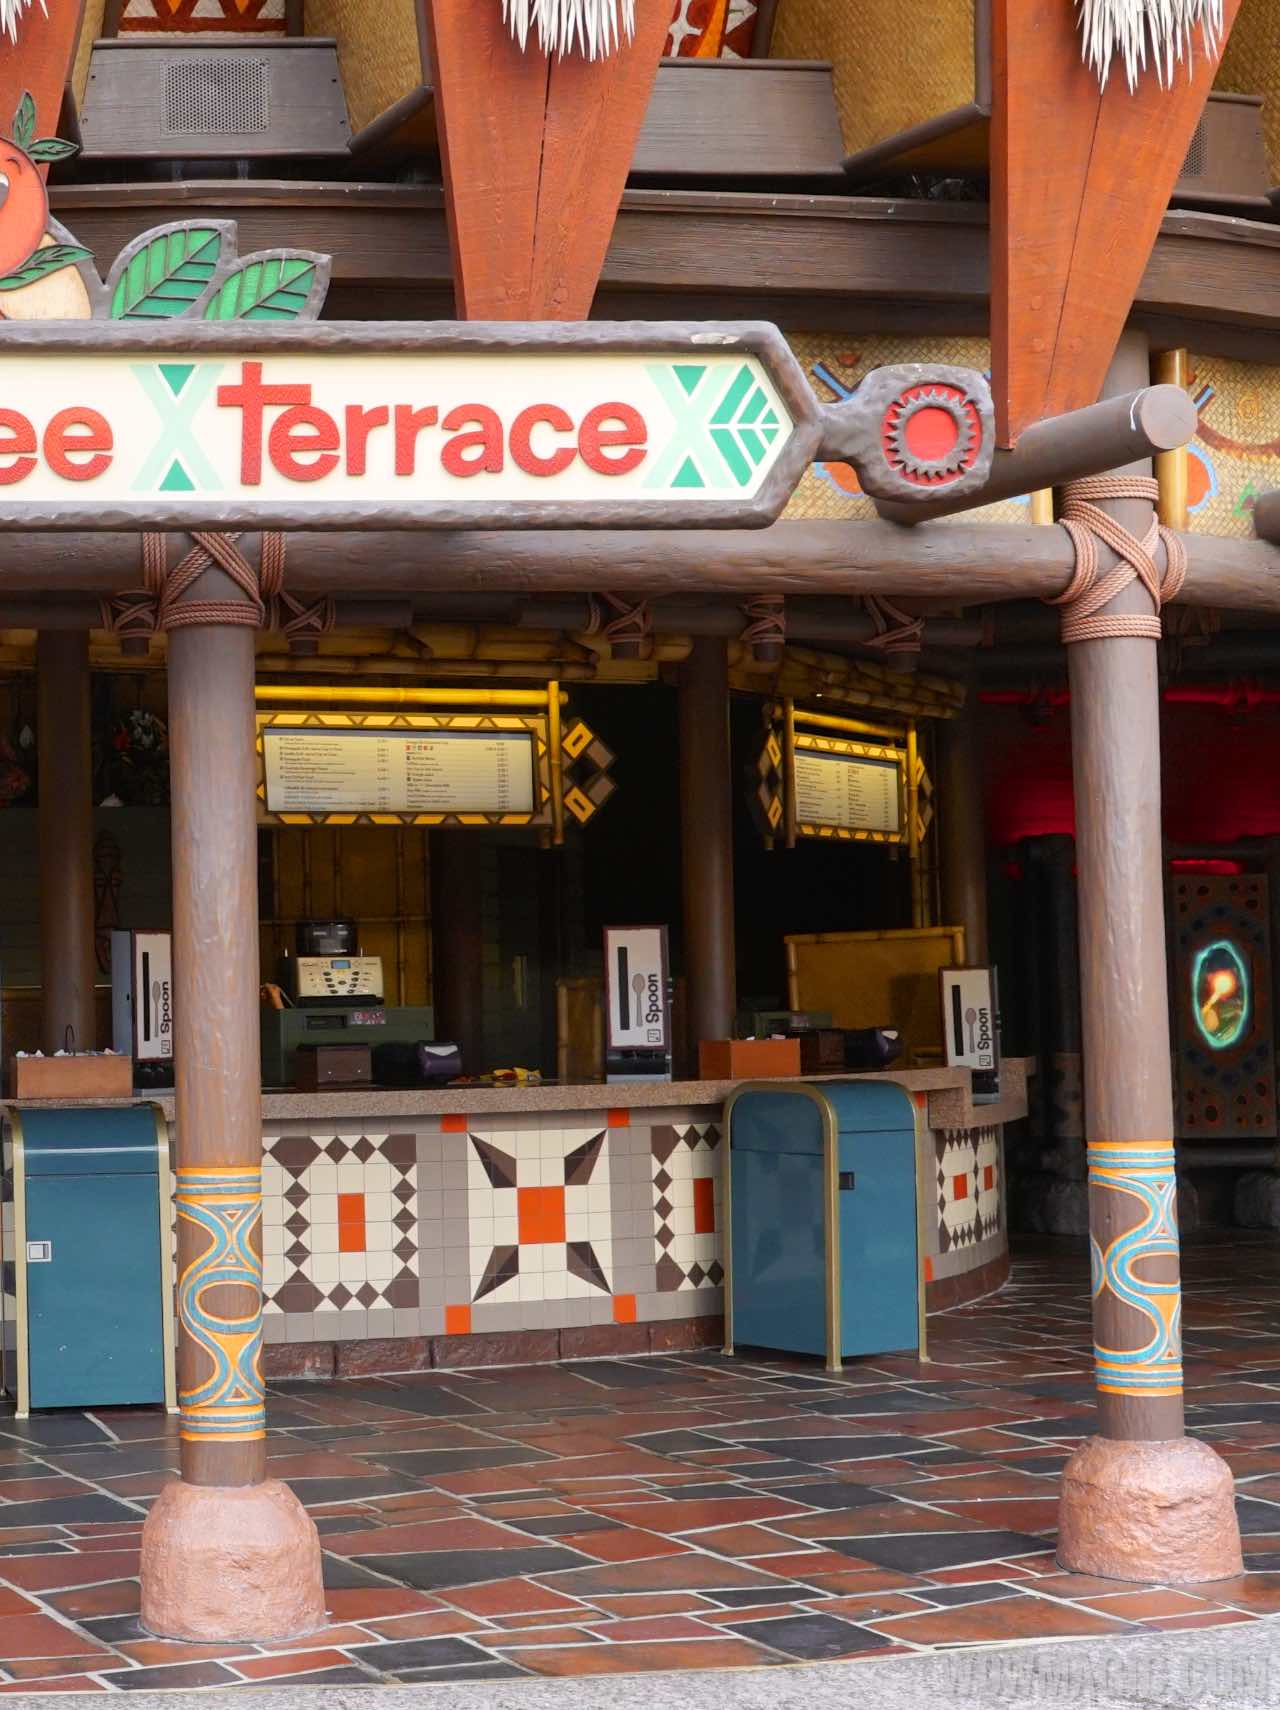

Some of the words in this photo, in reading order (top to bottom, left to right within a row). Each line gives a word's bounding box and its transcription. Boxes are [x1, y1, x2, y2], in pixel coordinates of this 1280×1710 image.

[216, 360, 648, 487] Terrace
[160, 981, 172, 1034] Spoon
[645, 974, 663, 1023] Spoon
[977, 1007, 992, 1050] Spoon
